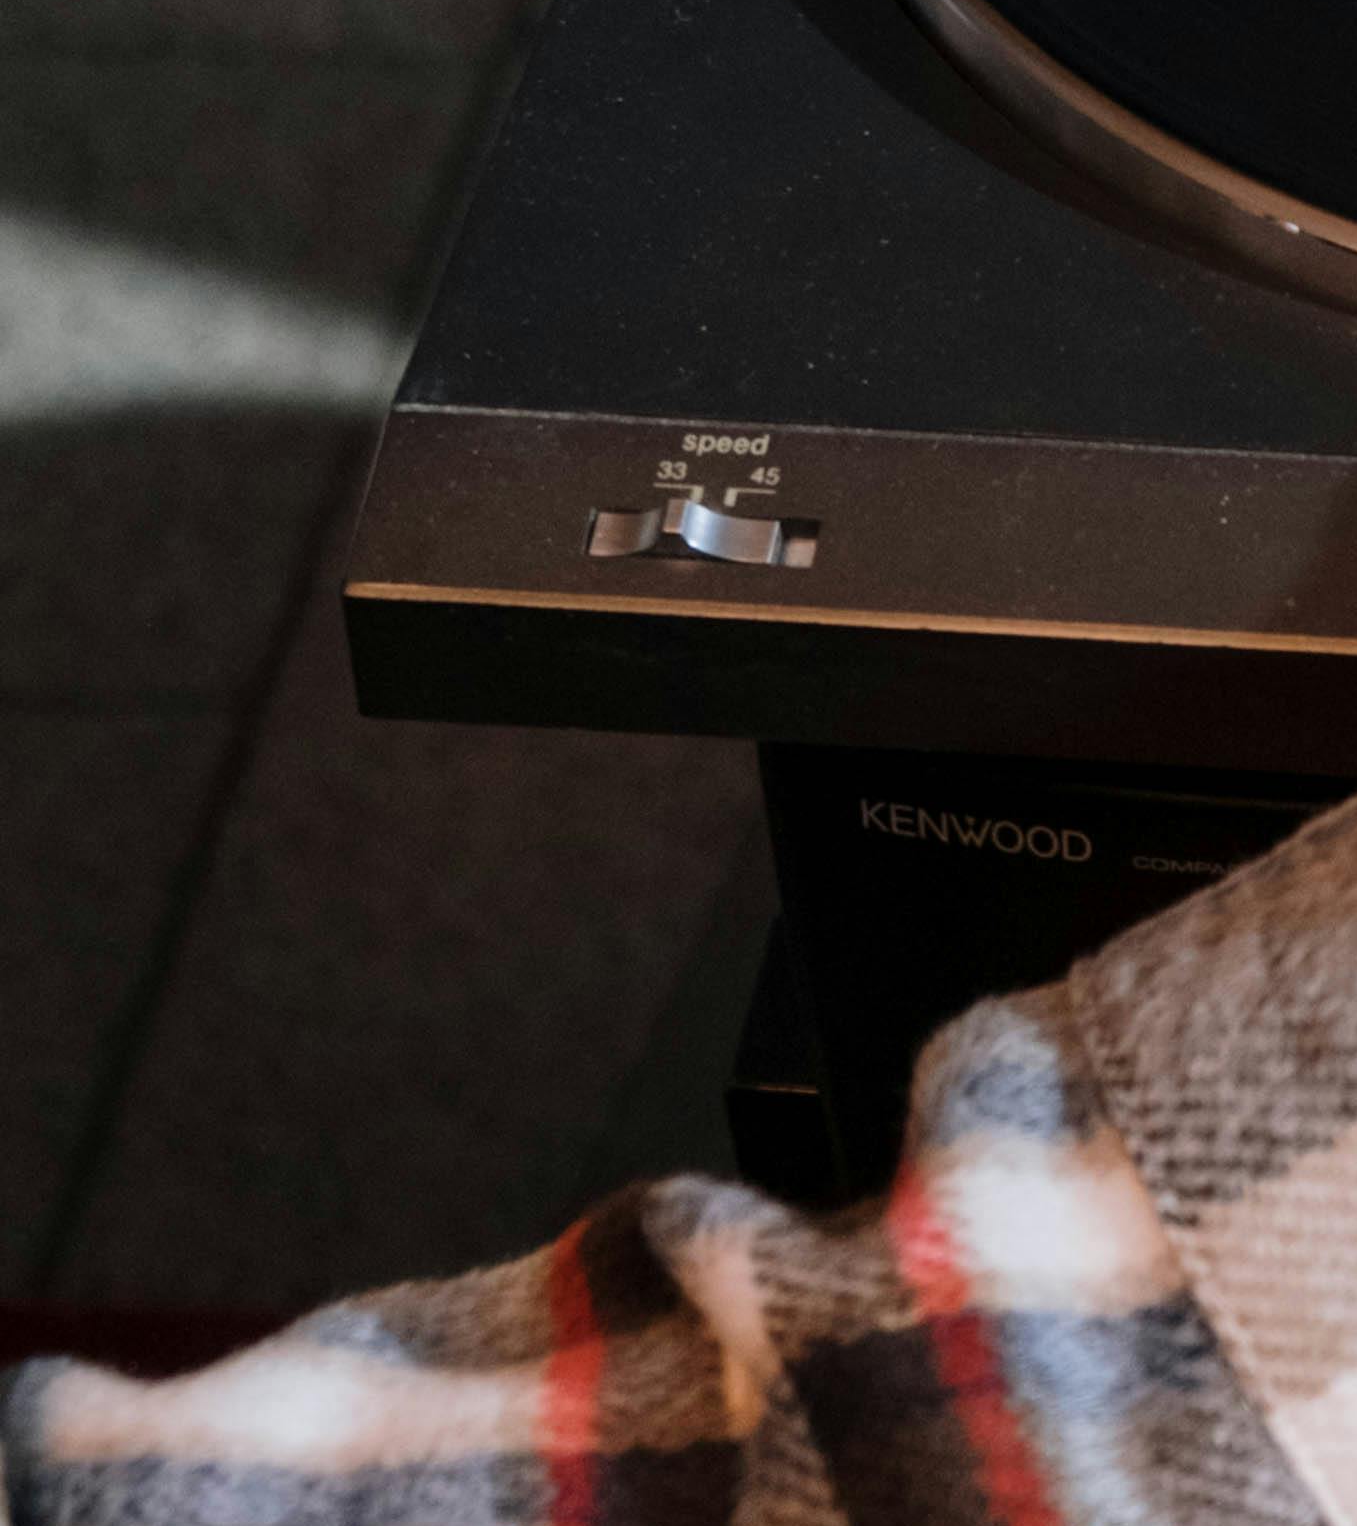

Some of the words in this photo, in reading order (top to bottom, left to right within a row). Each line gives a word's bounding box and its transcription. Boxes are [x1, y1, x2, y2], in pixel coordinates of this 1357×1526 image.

[682, 433, 770, 456] speed
[657, 461, 687, 480] 33
[750, 467, 780, 486] 45
[860, 798, 1093, 862] KENWOOD
